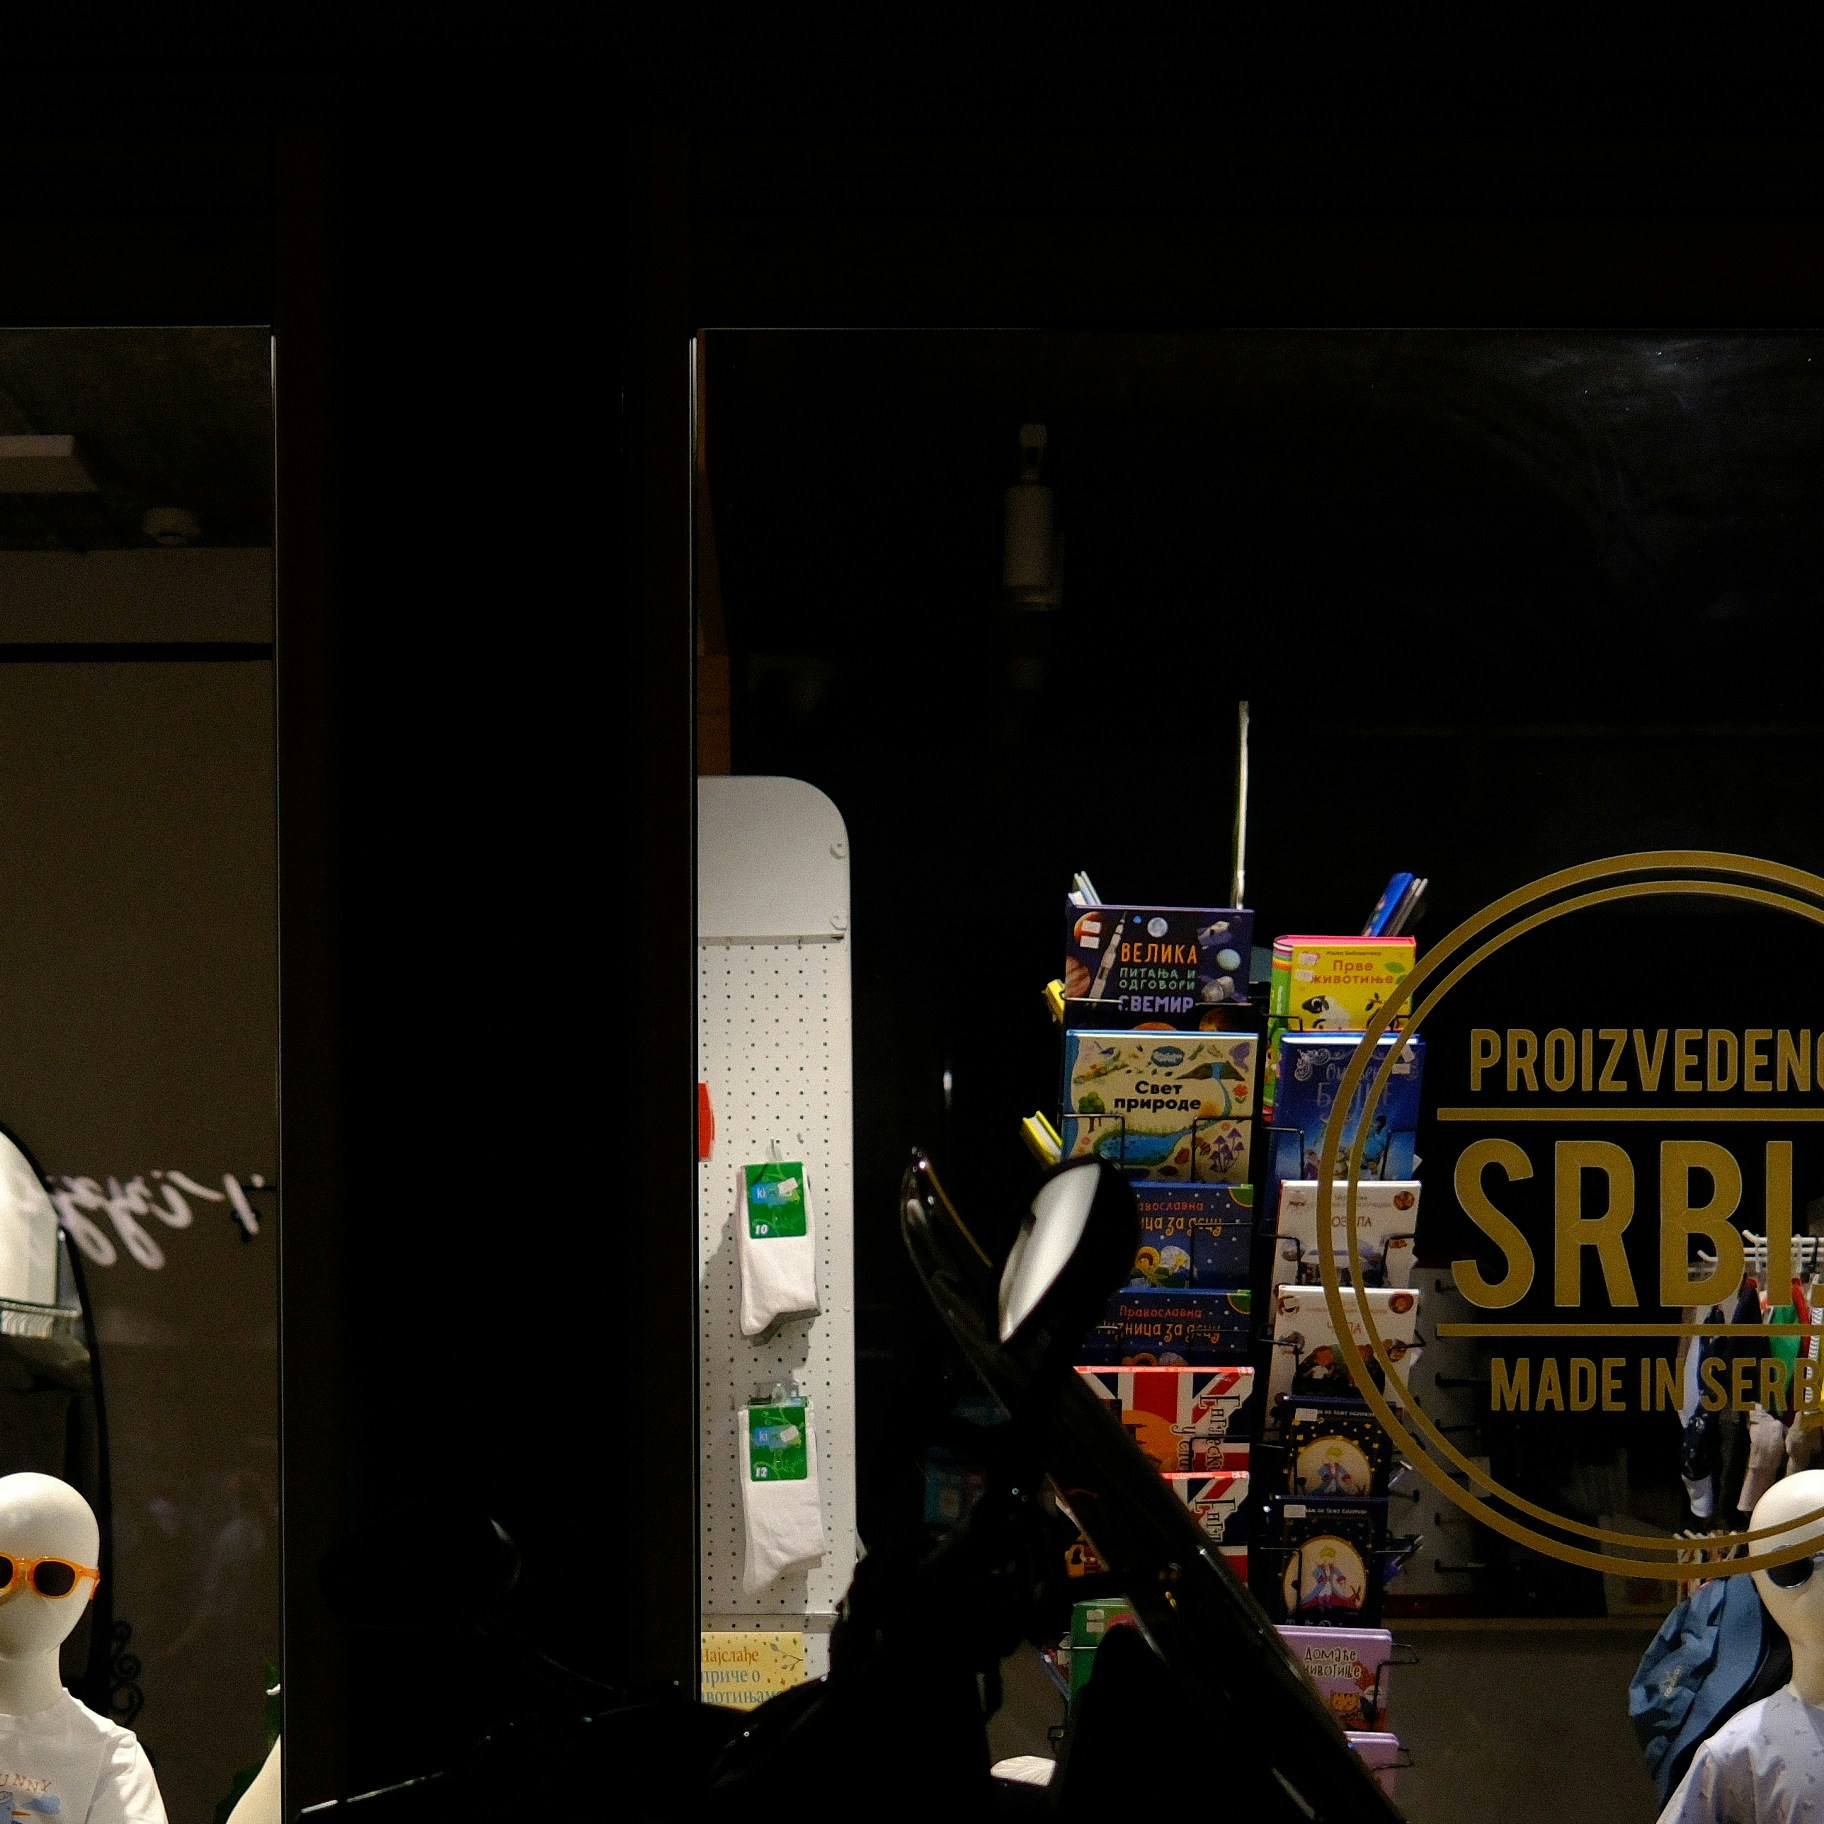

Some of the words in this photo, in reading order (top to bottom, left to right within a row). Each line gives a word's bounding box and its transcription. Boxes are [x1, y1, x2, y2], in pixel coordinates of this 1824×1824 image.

[1120, 942, 1199, 965] ВЕЛИКА
[1119, 967, 1178, 979] ПИТАЊА
[1187, 969, 1196, 979] И
[1333, 960, 1373, 974] Прве
[1118, 979, 1196, 991] ОДГОВОРИ
[1311, 975, 1394, 984] животиње
[1118, 995, 1194, 1013] СВЕМИР
[1135, 1080, 1183, 1095] Свет
[1114, 1098, 1201, 1114] природе
[1489, 1357, 1623, 1412] MADE
[1641, 1357, 1685, 1412] IN
[1305, 1646, 1357, 1662] Домаће
[751, 1670, 761, 1683] о
